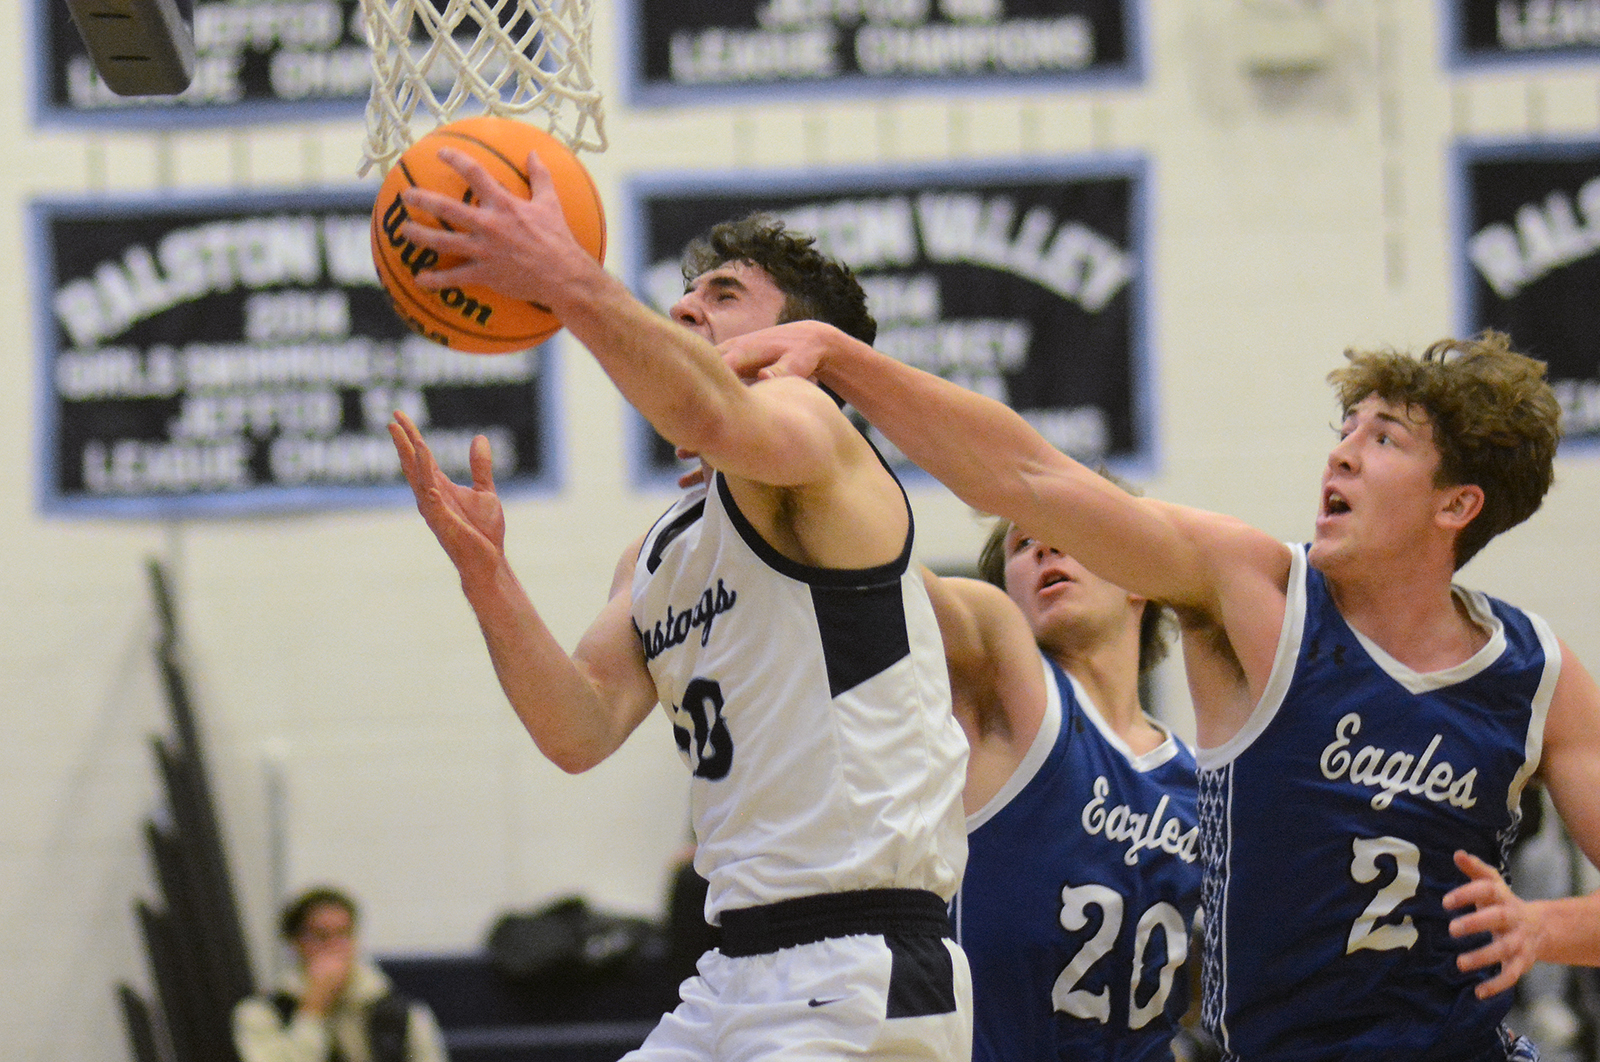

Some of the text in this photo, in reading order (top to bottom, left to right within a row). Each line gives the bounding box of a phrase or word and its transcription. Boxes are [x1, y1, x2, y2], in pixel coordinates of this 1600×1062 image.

[668, 14, 1096, 86] LEAGUE CHAMPIONS
[53, 212, 319, 347] RALSTON
[912, 192, 1134, 313] VALLEY
[56, 343, 178, 400] GIRLS
[80, 437, 250, 495] LEAGUE
[1320, 712, 1478, 811] Eagles
[1081, 775, 1200, 866] Eagles
[1346, 835, 1421, 956] 2
[1051, 883, 1188, 1031] 20
